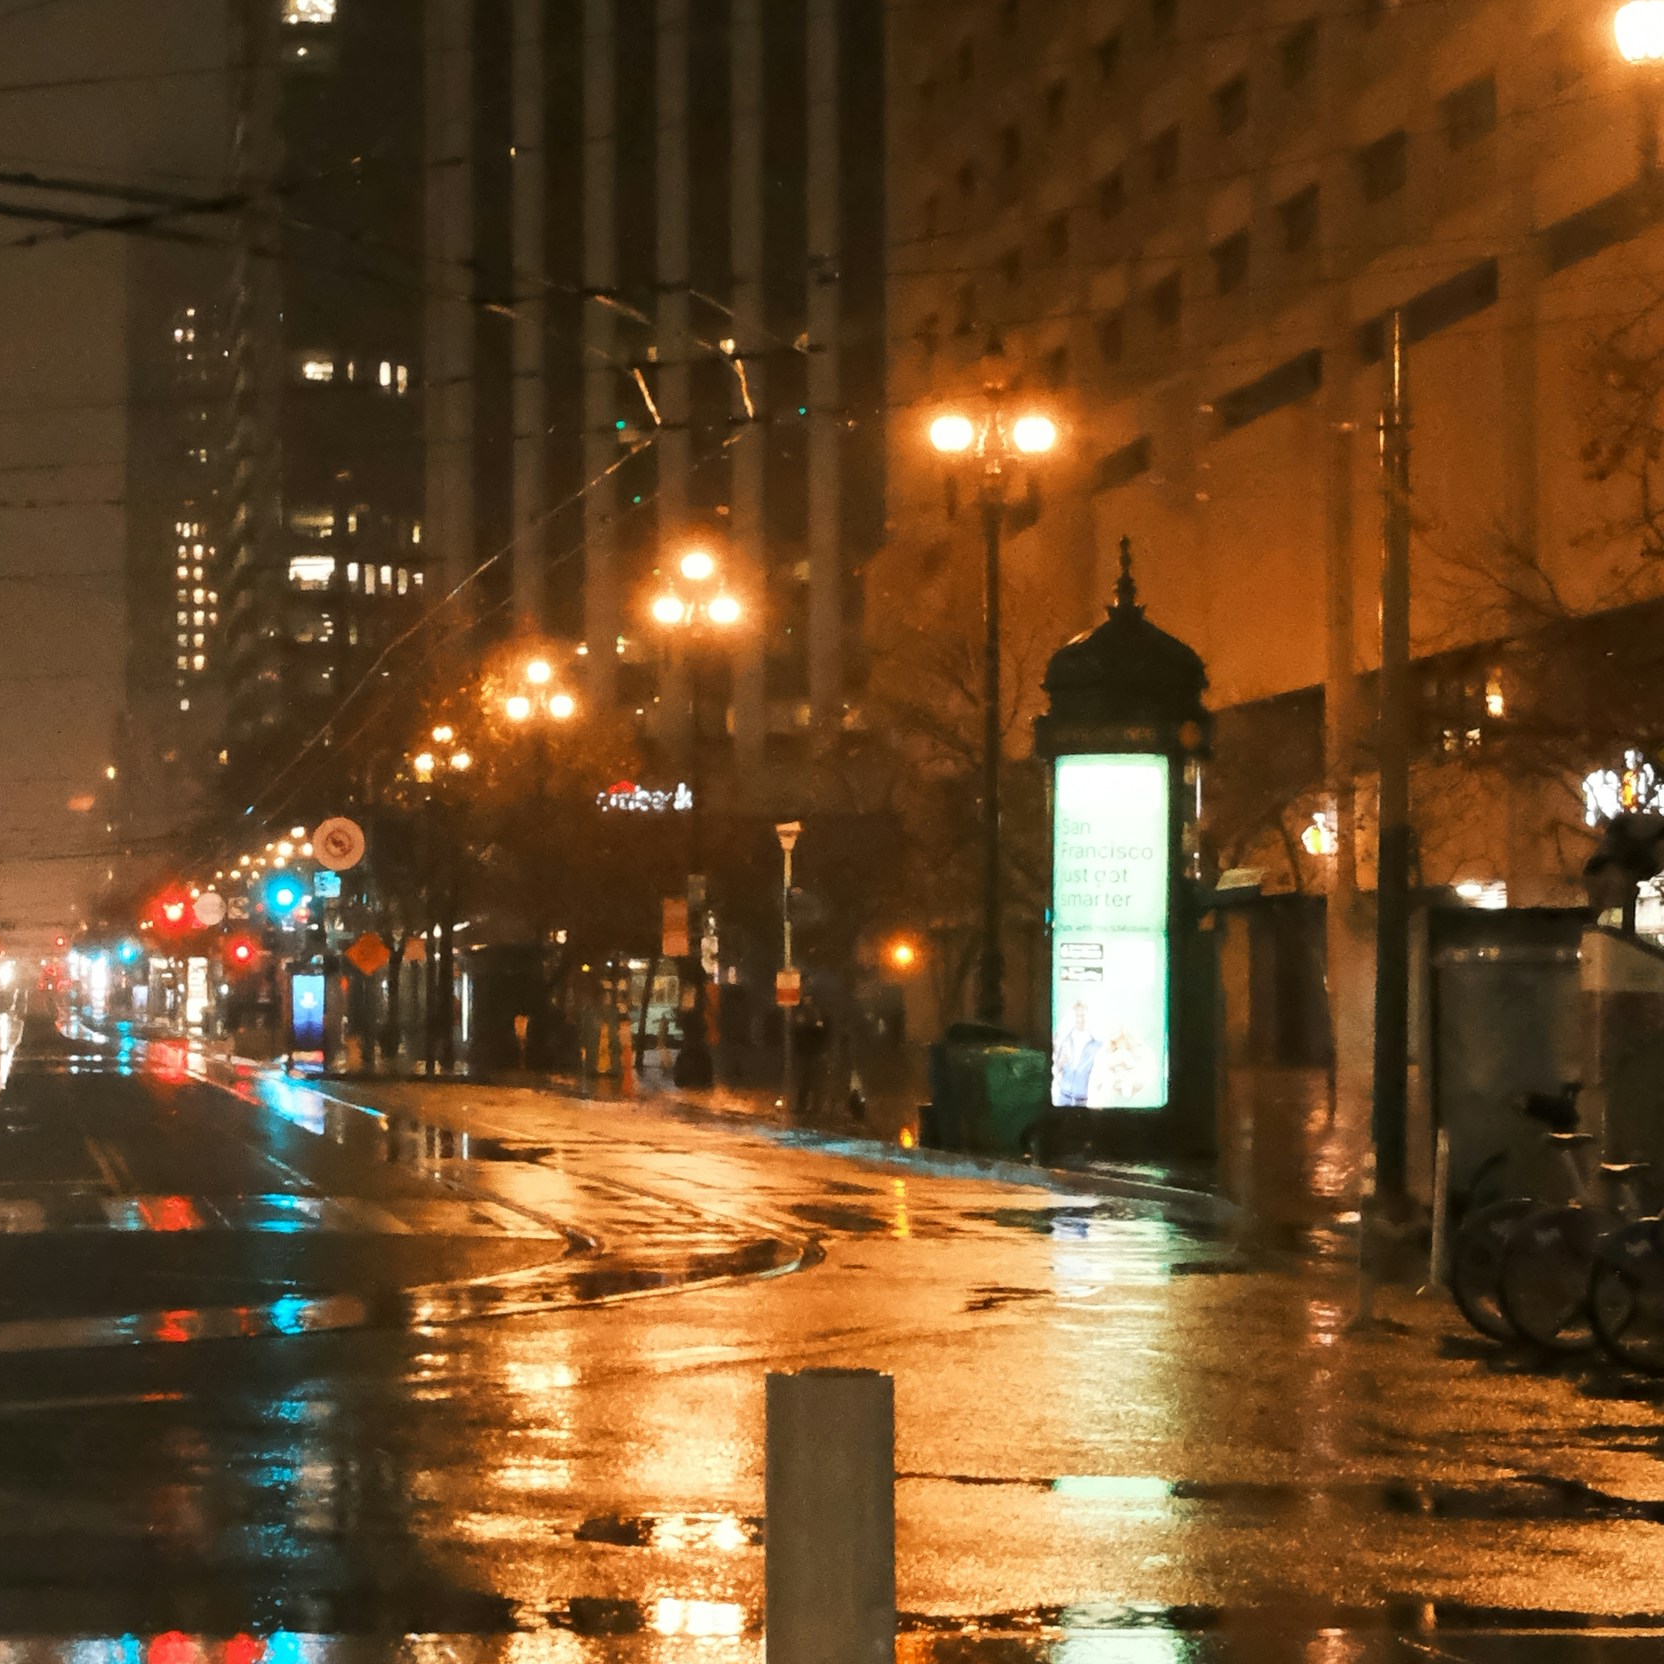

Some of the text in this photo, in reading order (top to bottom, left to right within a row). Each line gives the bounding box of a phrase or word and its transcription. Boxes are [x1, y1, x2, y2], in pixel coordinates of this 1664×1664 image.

[1061, 817, 1091, 835] San
[1061, 841, 1154, 860] Francisco
[1094, 867, 1128, 888] got
[1061, 892, 1133, 909] smarter
